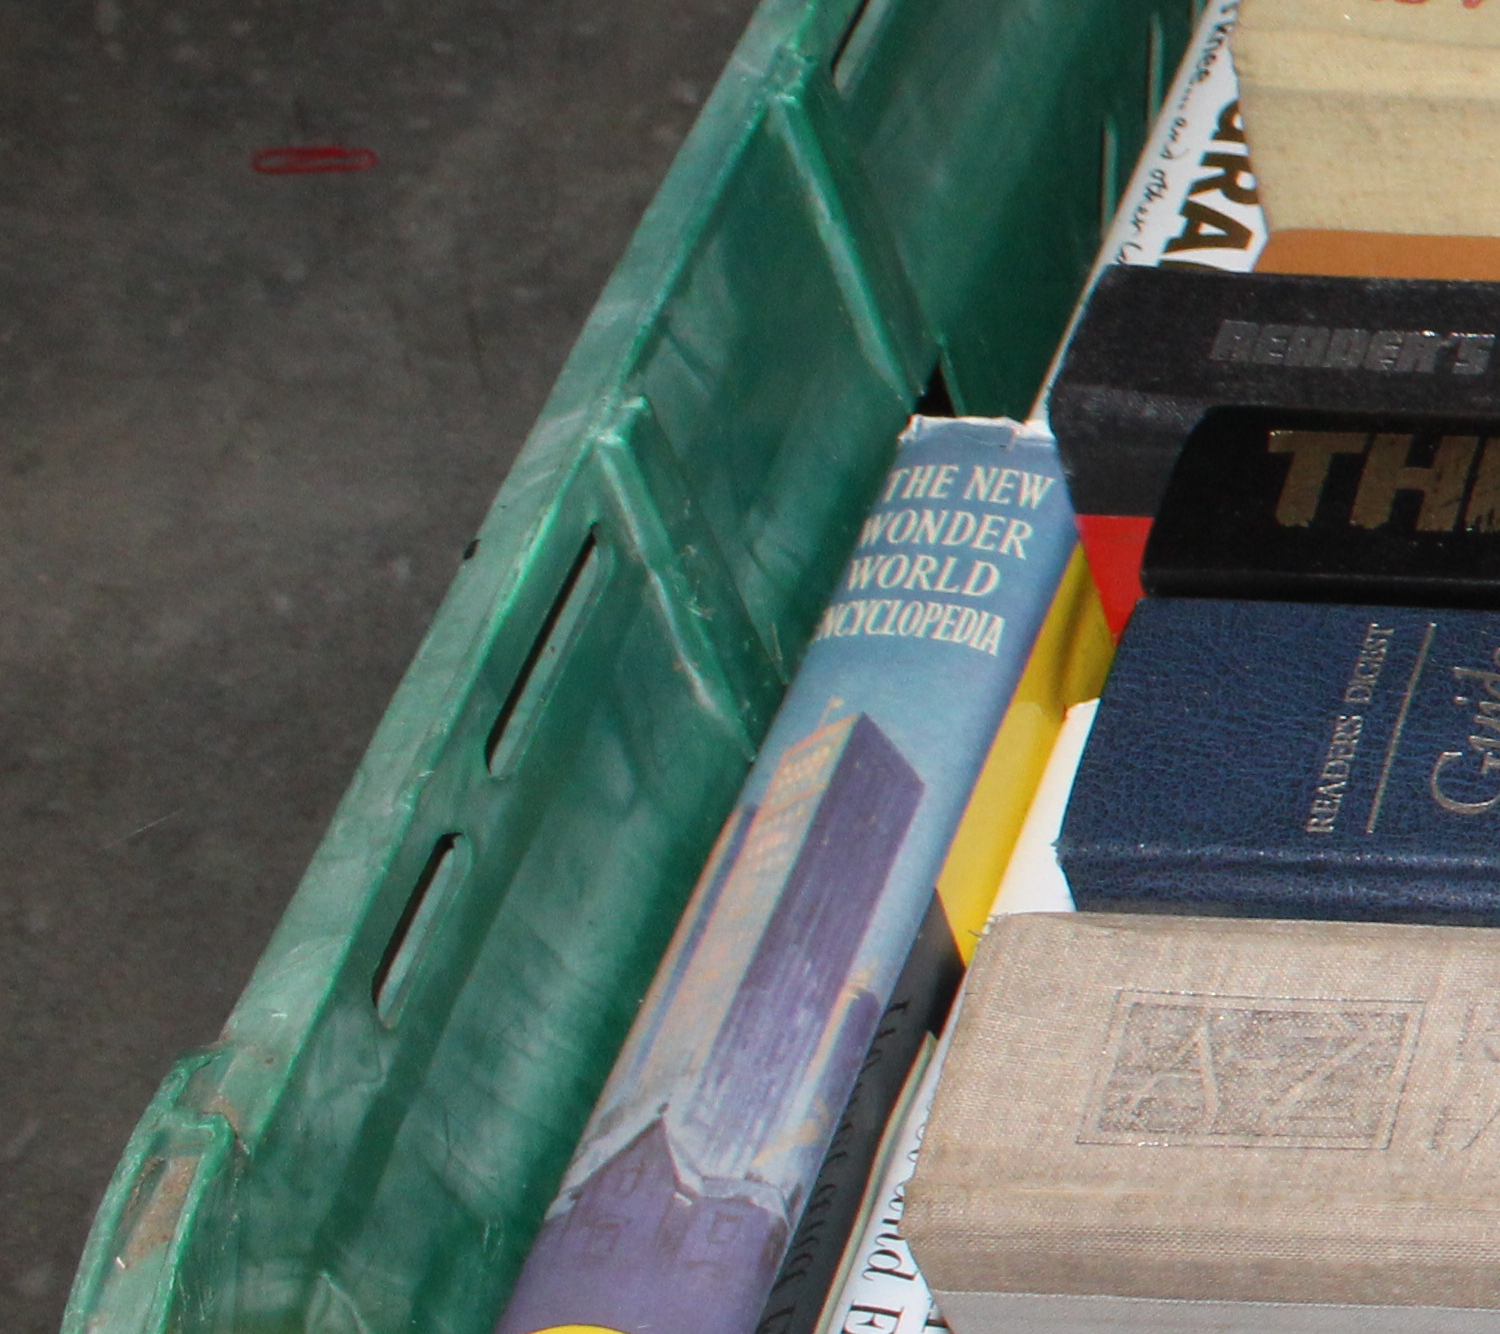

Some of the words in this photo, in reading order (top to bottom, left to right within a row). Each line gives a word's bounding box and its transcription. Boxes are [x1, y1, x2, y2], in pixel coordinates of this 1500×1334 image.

[1208, 318, 1497, 376] READER'S
[883, 464, 959, 503] THE
[963, 465, 1056, 510] NEW
[857, 509, 1034, 560] WONDER
[846, 554, 1001, 597] WORLD
[1344, 622, 1395, 705] DIGEST
